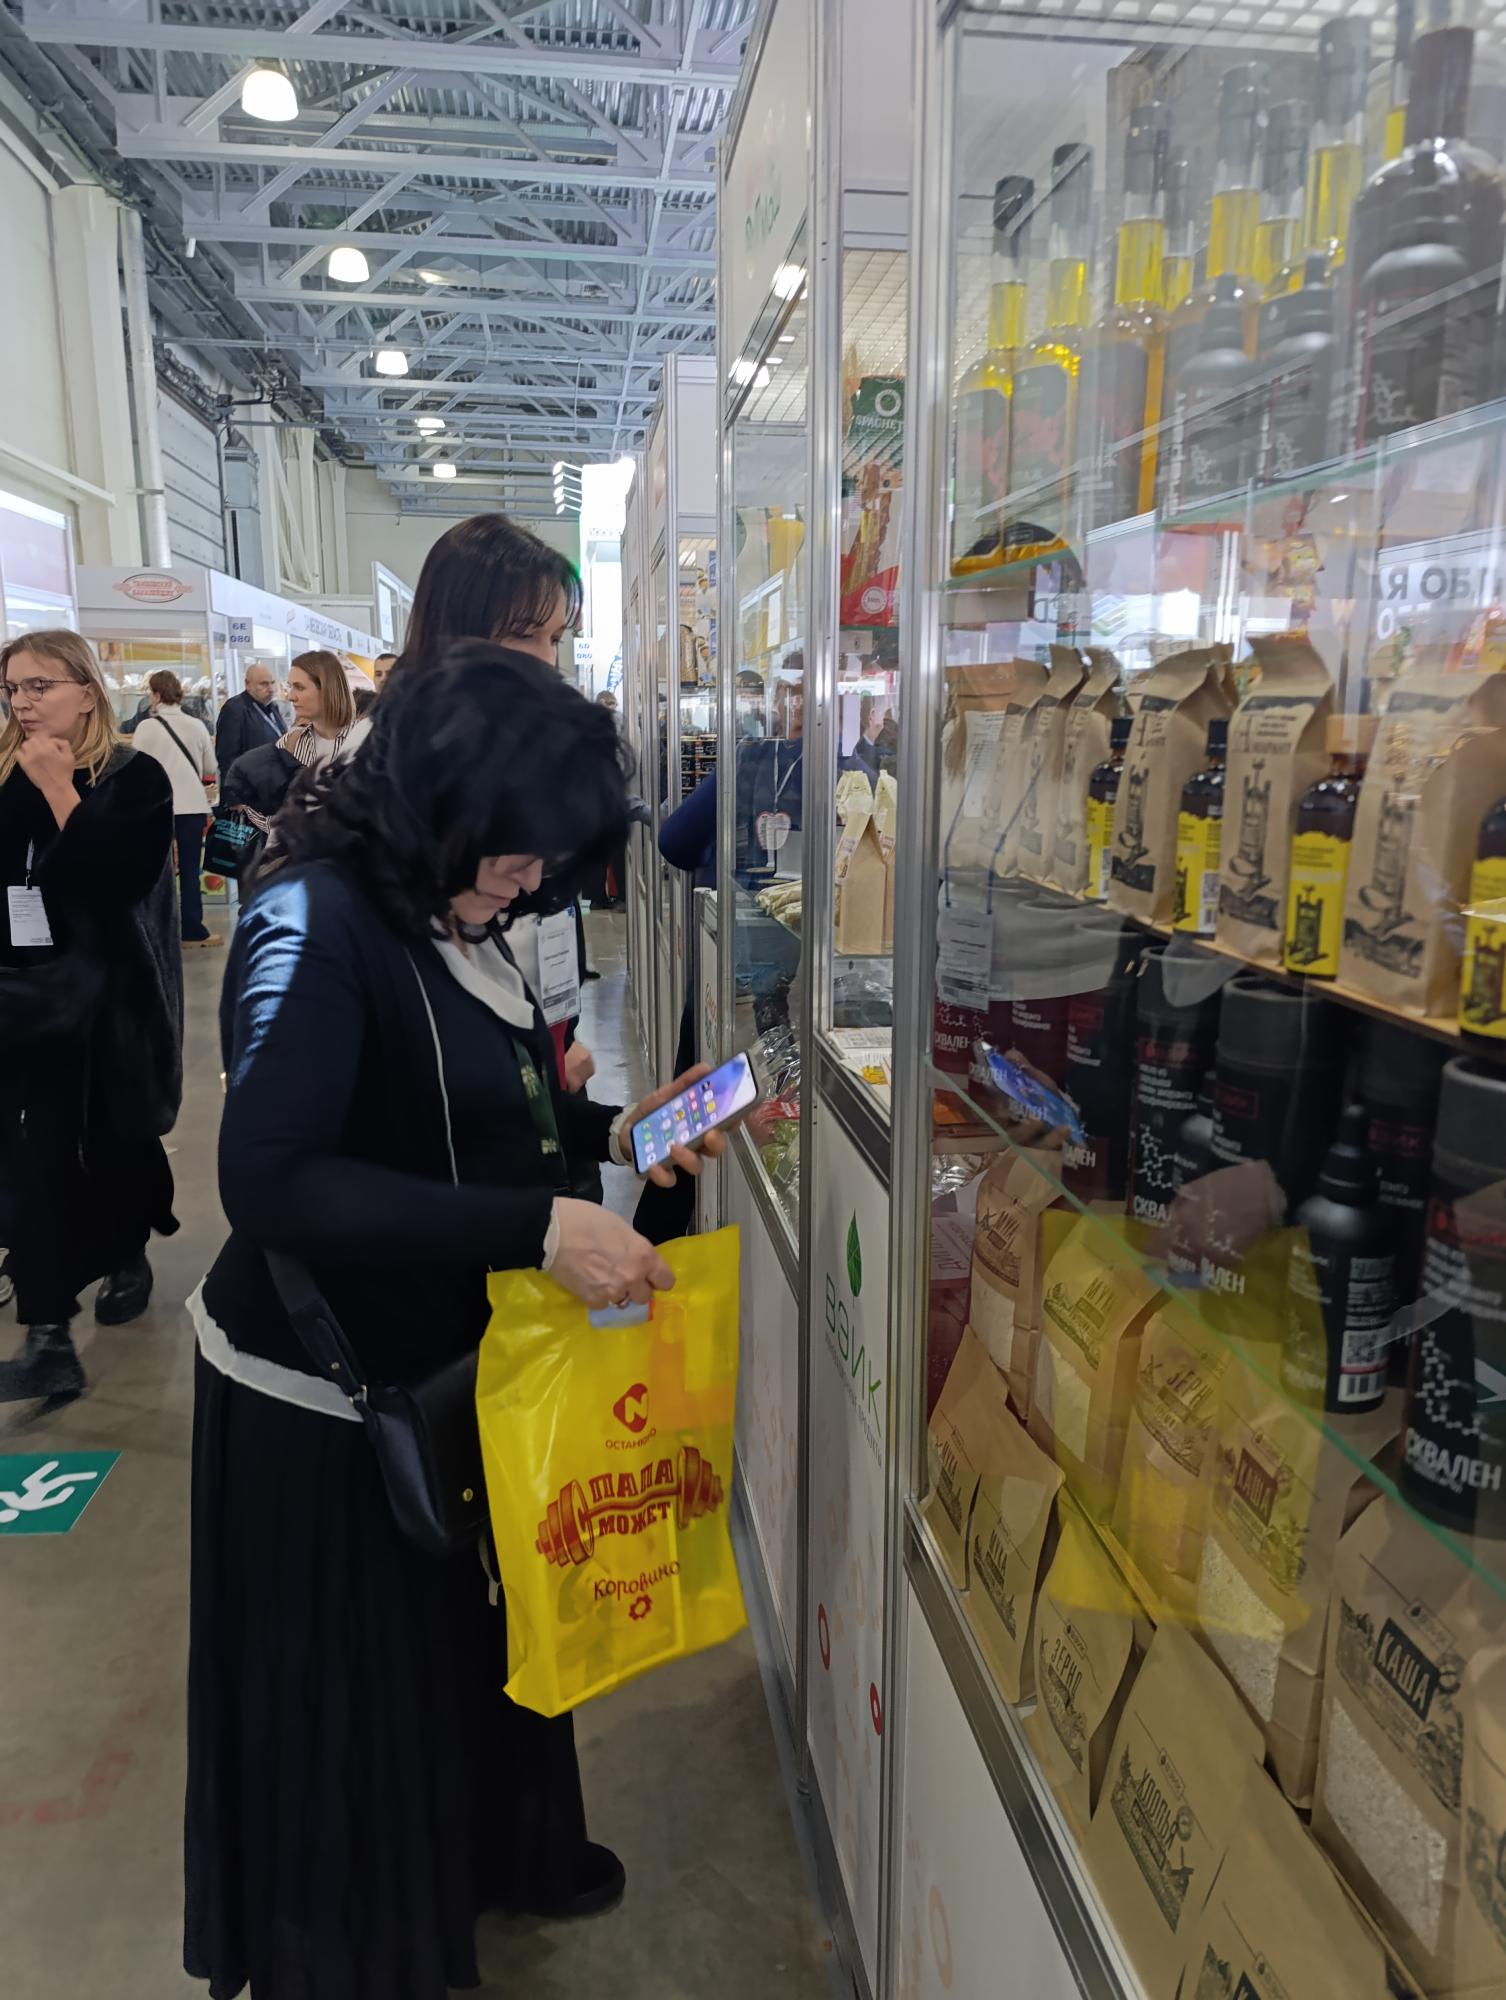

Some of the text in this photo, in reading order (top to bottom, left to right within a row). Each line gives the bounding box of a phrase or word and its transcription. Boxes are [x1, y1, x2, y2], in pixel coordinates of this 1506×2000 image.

[826, 1271, 882, 1438] ВЭИК
[588, 1458, 674, 1503] ПАПА
[598, 1501, 671, 1536] МОЖЕТ
[594, 1561, 680, 1601] Коровино
[1050, 1637, 1083, 1697] ЗЕРНО
[1377, 1633, 1431, 1711] КАША
[1135, 1767, 1178, 1850] ХЛОПЬЯ
